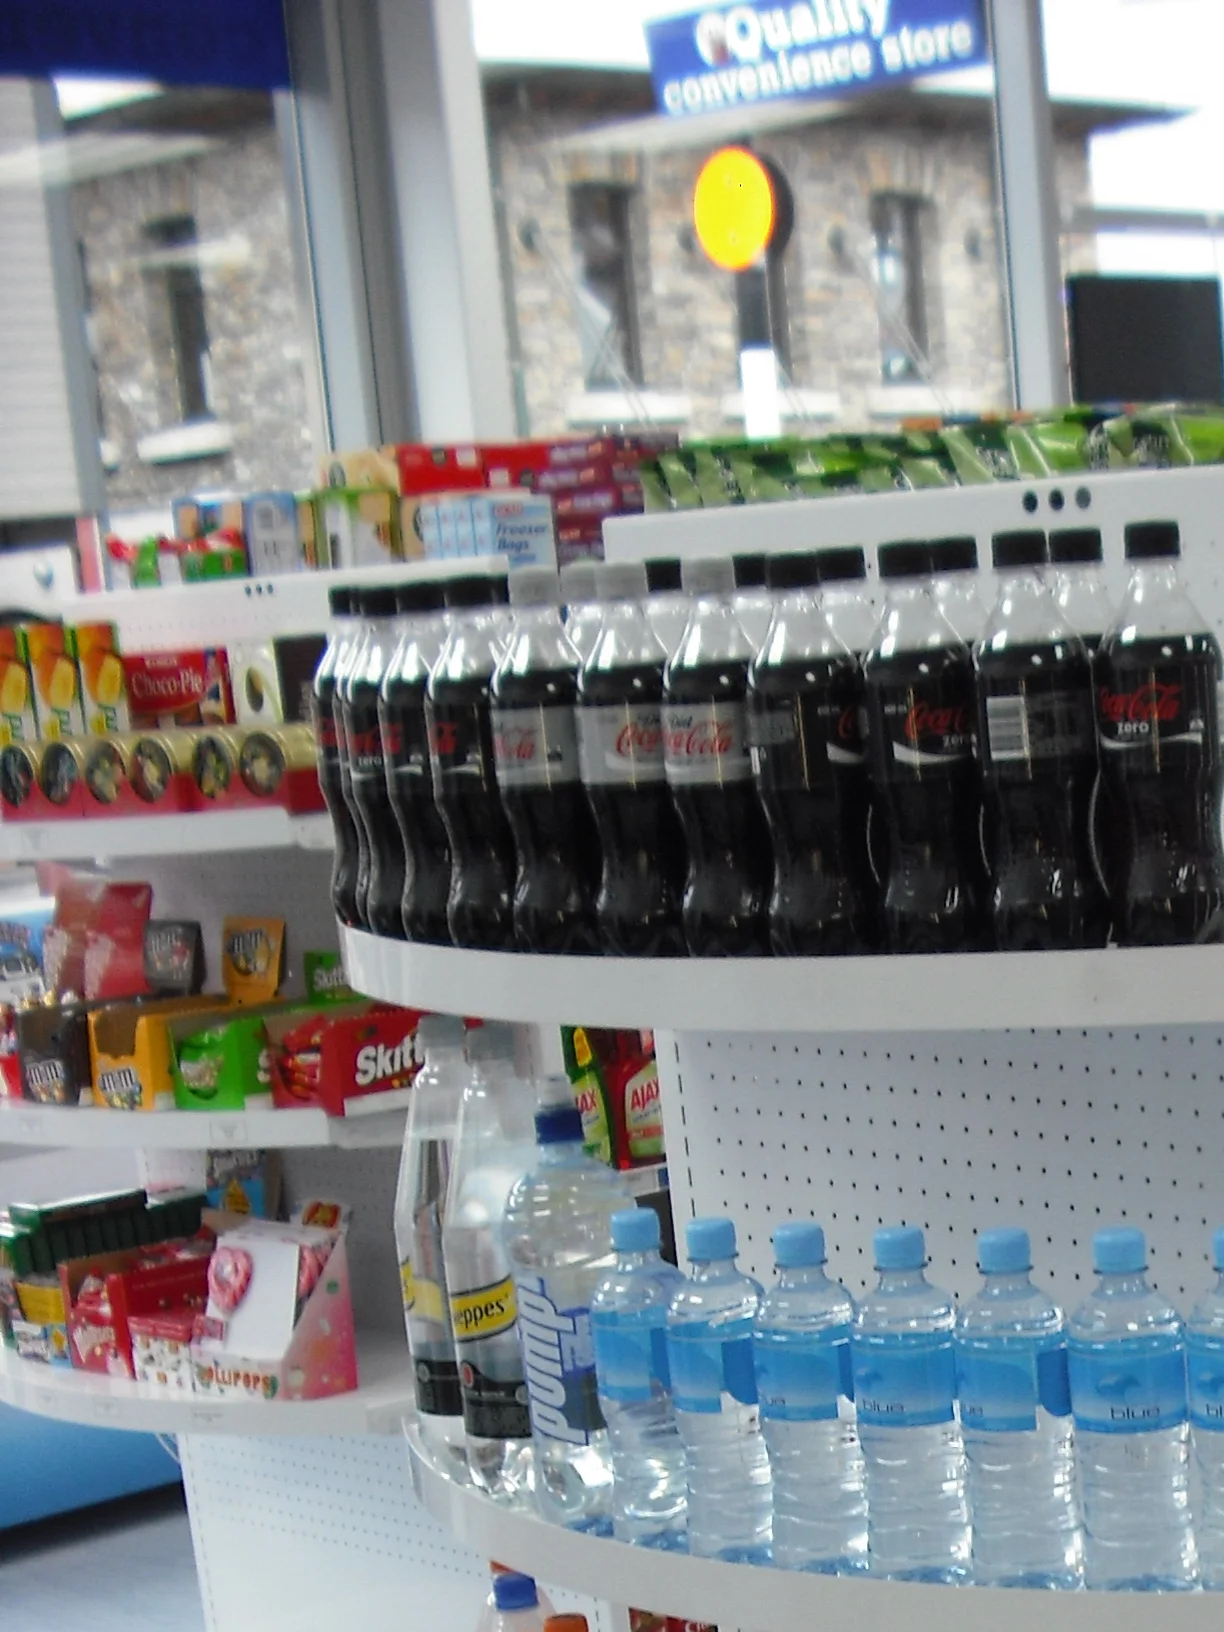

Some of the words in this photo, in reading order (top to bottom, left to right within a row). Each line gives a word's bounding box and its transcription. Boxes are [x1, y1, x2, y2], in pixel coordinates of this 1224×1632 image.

[664, 42, 872, 116] convenience
[882, 21, 973, 73] store
[1117, 721, 1150, 735] zero
[1110, 1404, 1161, 1421] blue
